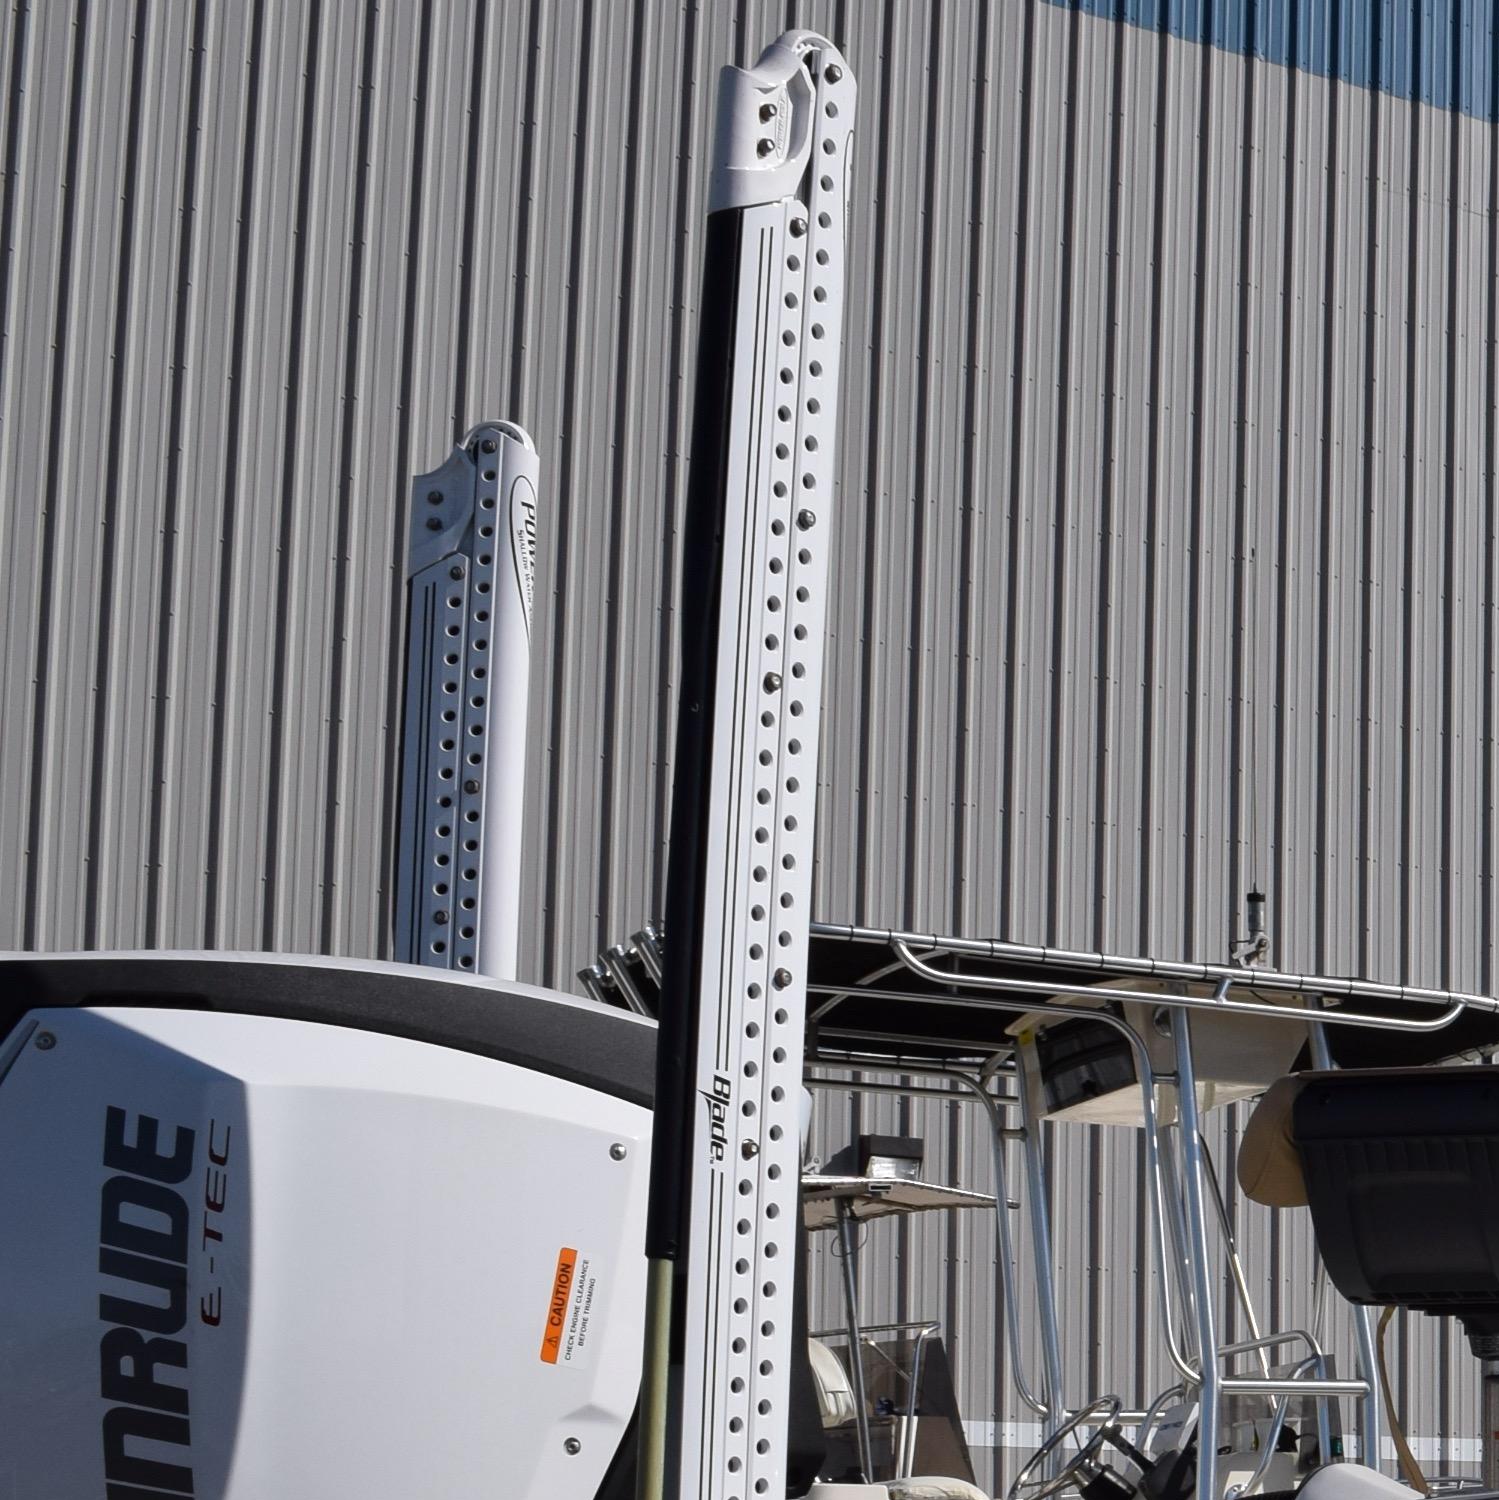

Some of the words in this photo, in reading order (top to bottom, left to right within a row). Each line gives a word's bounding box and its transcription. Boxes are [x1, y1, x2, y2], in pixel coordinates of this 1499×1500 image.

[697, 1074, 731, 1161] Blade
[550, 1263, 572, 1327] CAUTION
[564, 1335, 575, 1361] CHECK
[570, 1305, 580, 1334] ENGINE
[575, 1259, 589, 1304] CLEARANCE
[577, 1317, 589, 1347] BEFORE
[583, 1278, 596, 1315] TRIMMING
